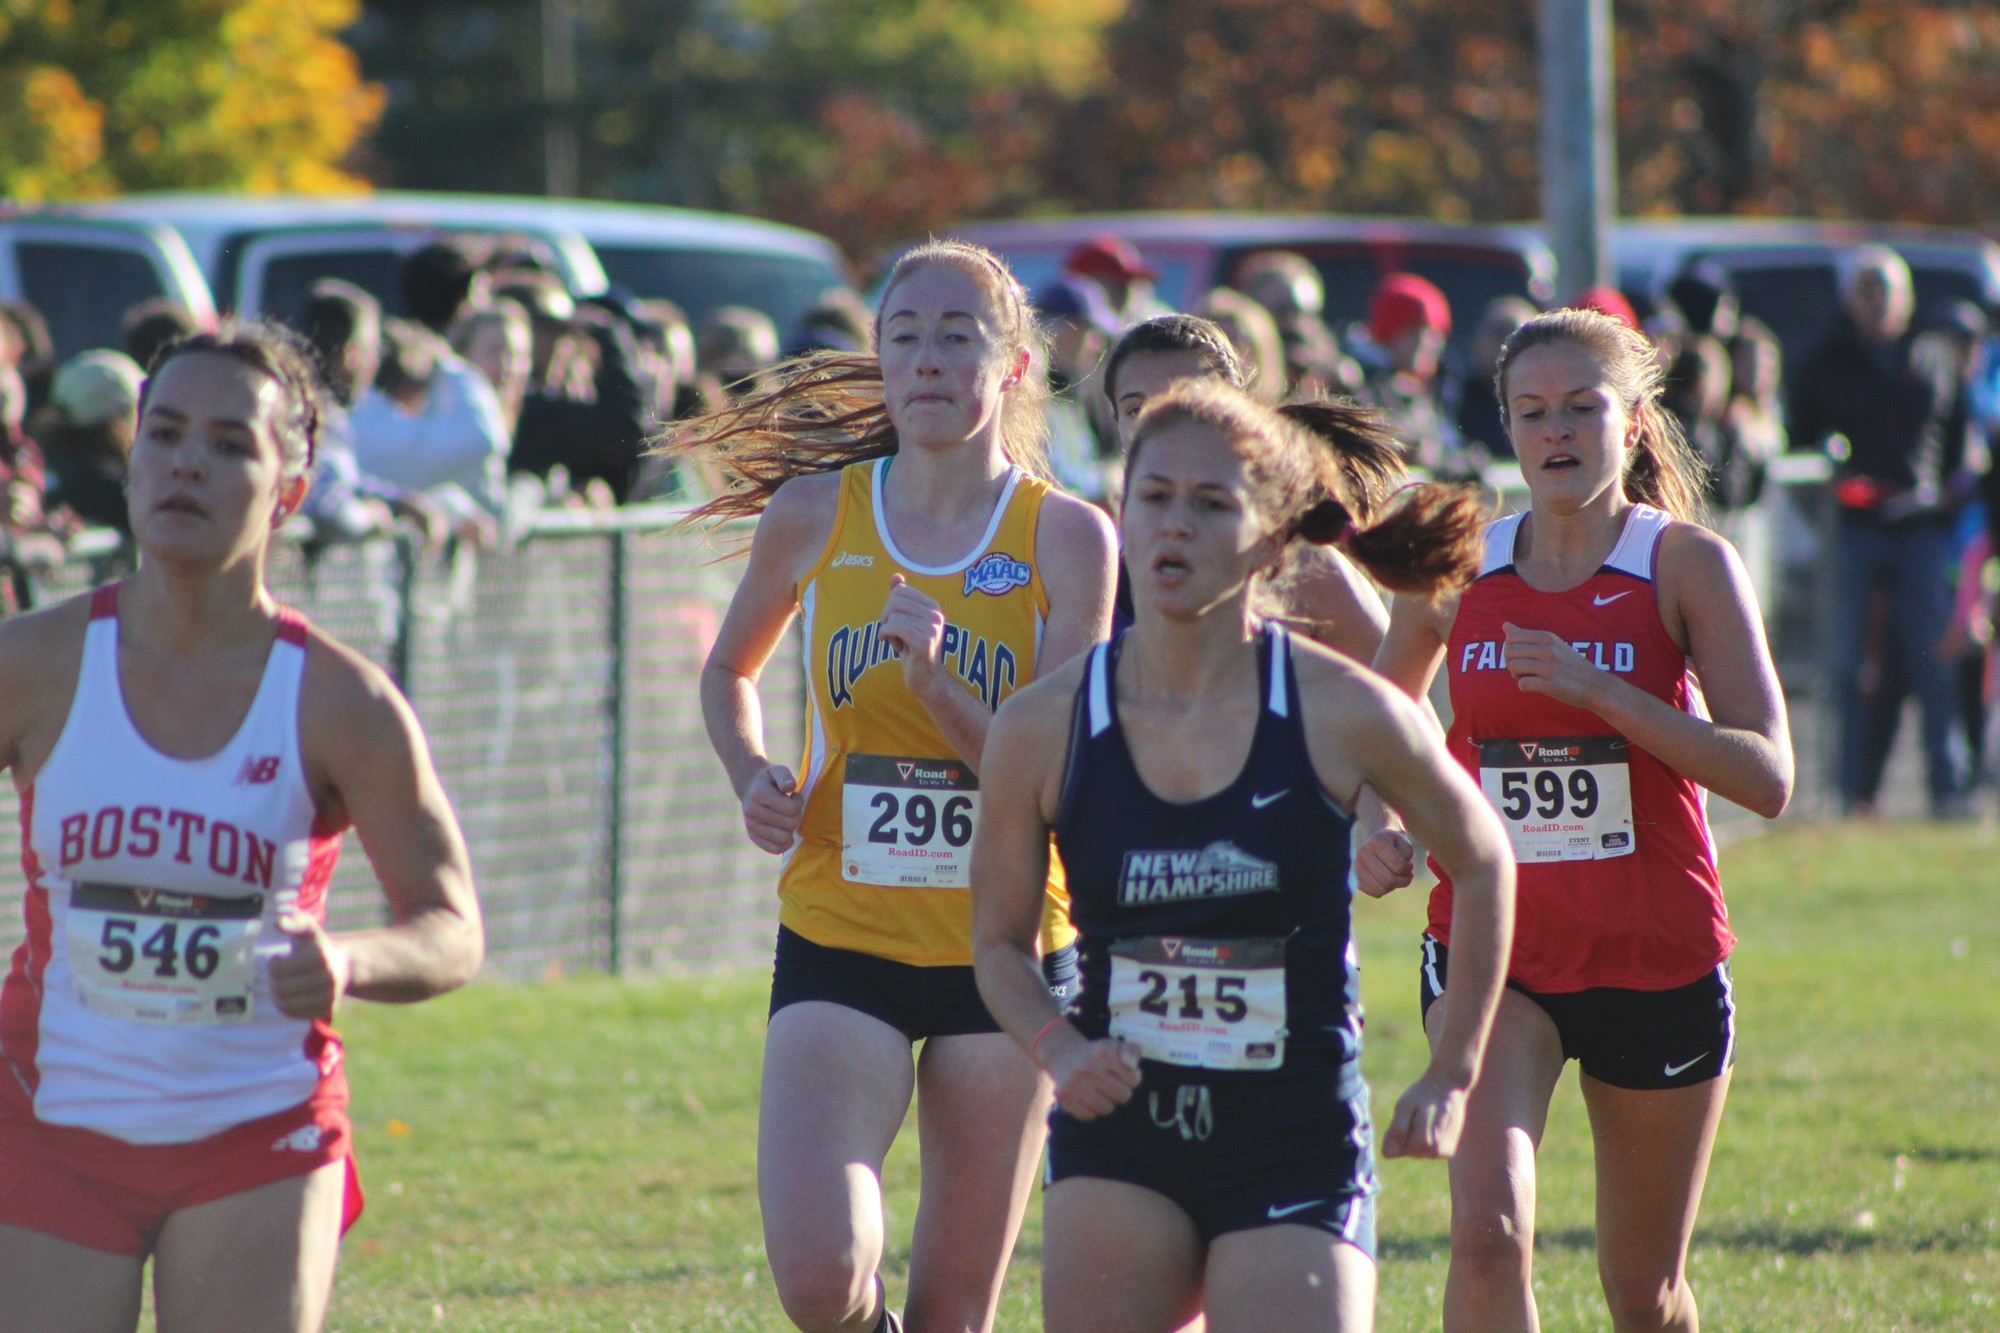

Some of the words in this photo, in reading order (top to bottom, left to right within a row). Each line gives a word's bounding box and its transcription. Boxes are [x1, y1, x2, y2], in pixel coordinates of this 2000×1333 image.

[964, 561, 1030, 595] MAAC
[1502, 769, 1599, 820] 599
[868, 792, 974, 847] 296
[1522, 824, 1584, 833] RoadID.com
[60, 806, 277, 890] BOSTON
[888, 847, 953, 859] RoadID.com
[1128, 853, 1197, 878] NEW
[1125, 869, 1276, 904] HAMPSHIRE
[99, 918, 220, 980] 546
[1138, 970, 1248, 1024] 215
